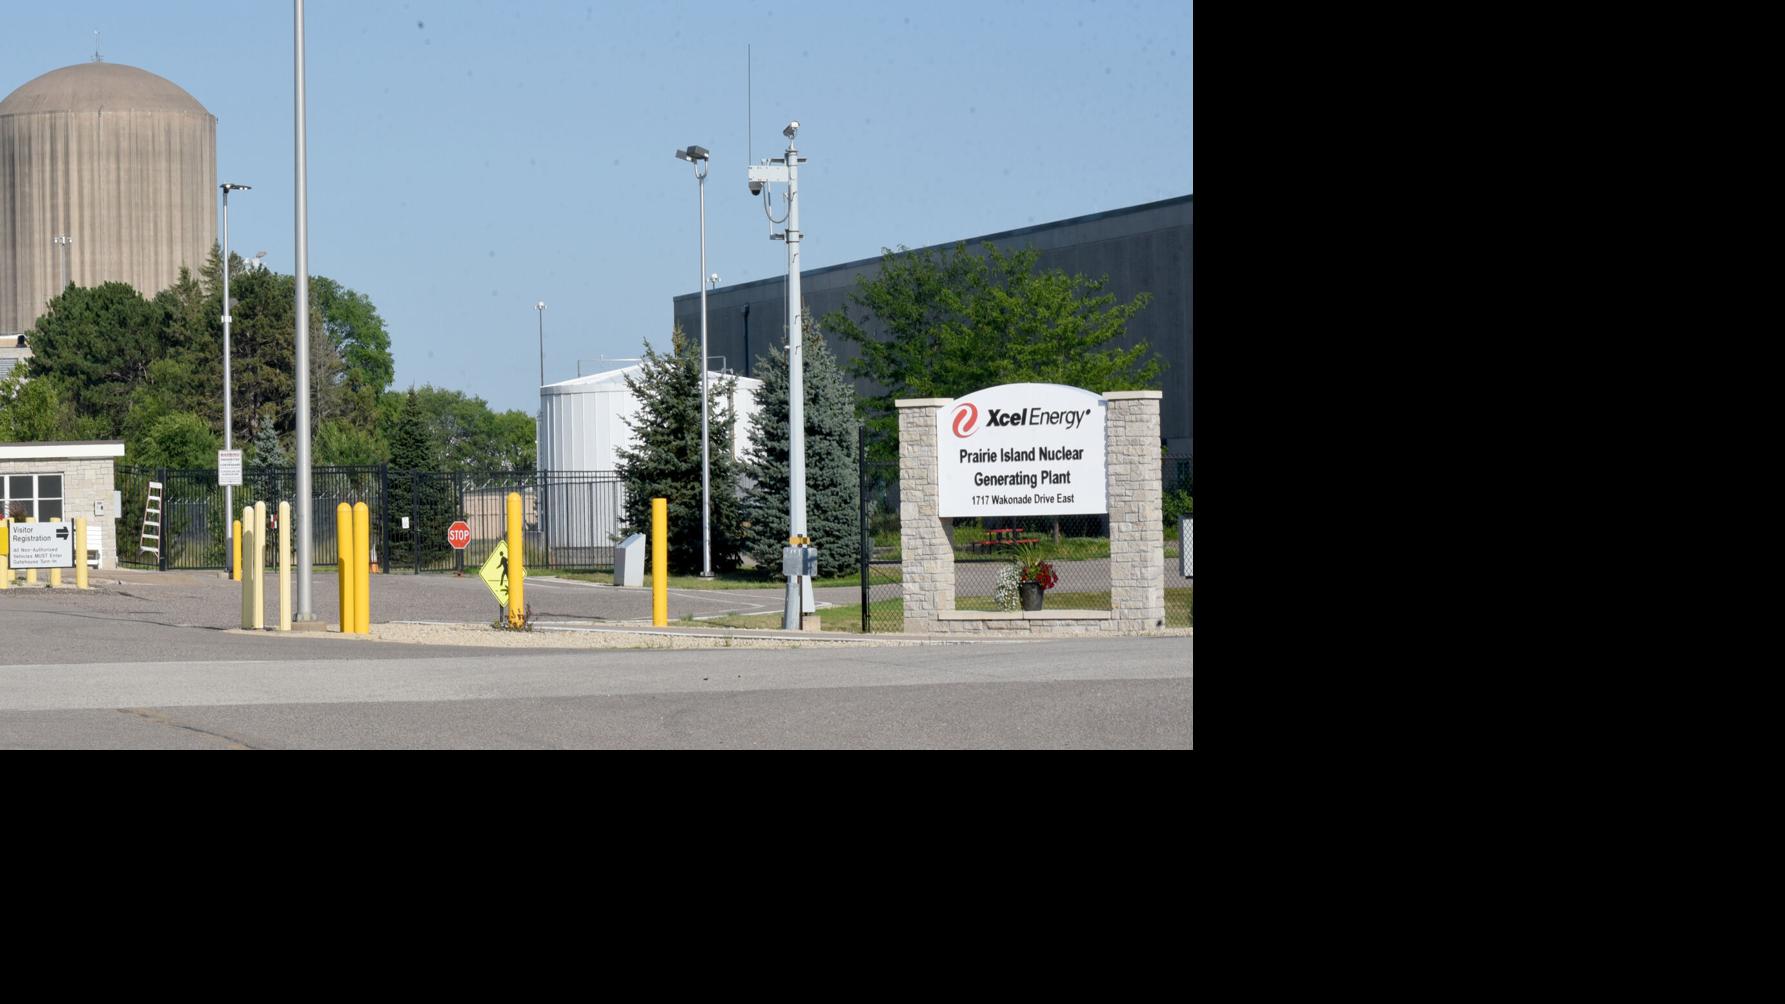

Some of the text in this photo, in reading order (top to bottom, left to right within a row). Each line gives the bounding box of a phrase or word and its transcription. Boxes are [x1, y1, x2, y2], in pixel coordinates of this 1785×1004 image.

[986, 408, 1027, 427] Xcel
[960, 446, 1084, 463] Prairie Island Nuclear
[974, 470, 1071, 489] Generating Plant
[972, 493, 1074, 505] 1717 Wakonade Drive East
[13, 526, 33, 534] Visitor
[449, 529, 470, 541] STOP
[13, 535, 52, 543] Registration
